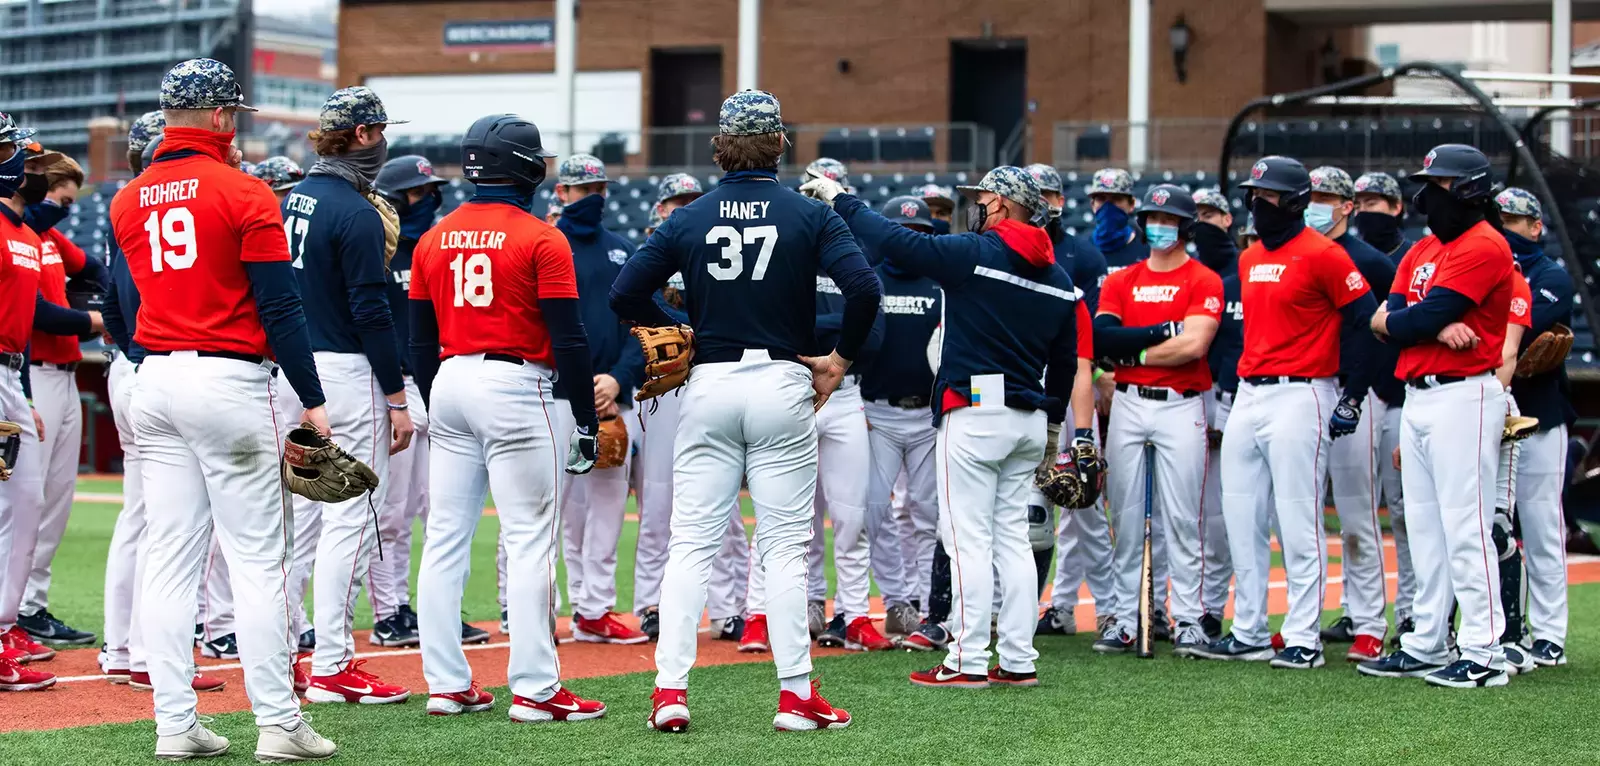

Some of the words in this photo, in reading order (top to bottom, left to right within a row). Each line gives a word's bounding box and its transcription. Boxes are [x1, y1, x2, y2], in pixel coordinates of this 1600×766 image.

[447, 24, 550, 41] MERCHANDISE
[140, 178, 199, 208] ROHRER
[286, 193, 318, 216] PETERS
[720, 201, 770, 220] HANEY
[144, 206, 198, 273] 19
[283, 215, 310, 270] 17
[440, 230, 507, 250] LOCKLEAR
[705, 225, 779, 281] 37
[449, 252, 494, 308] 18
